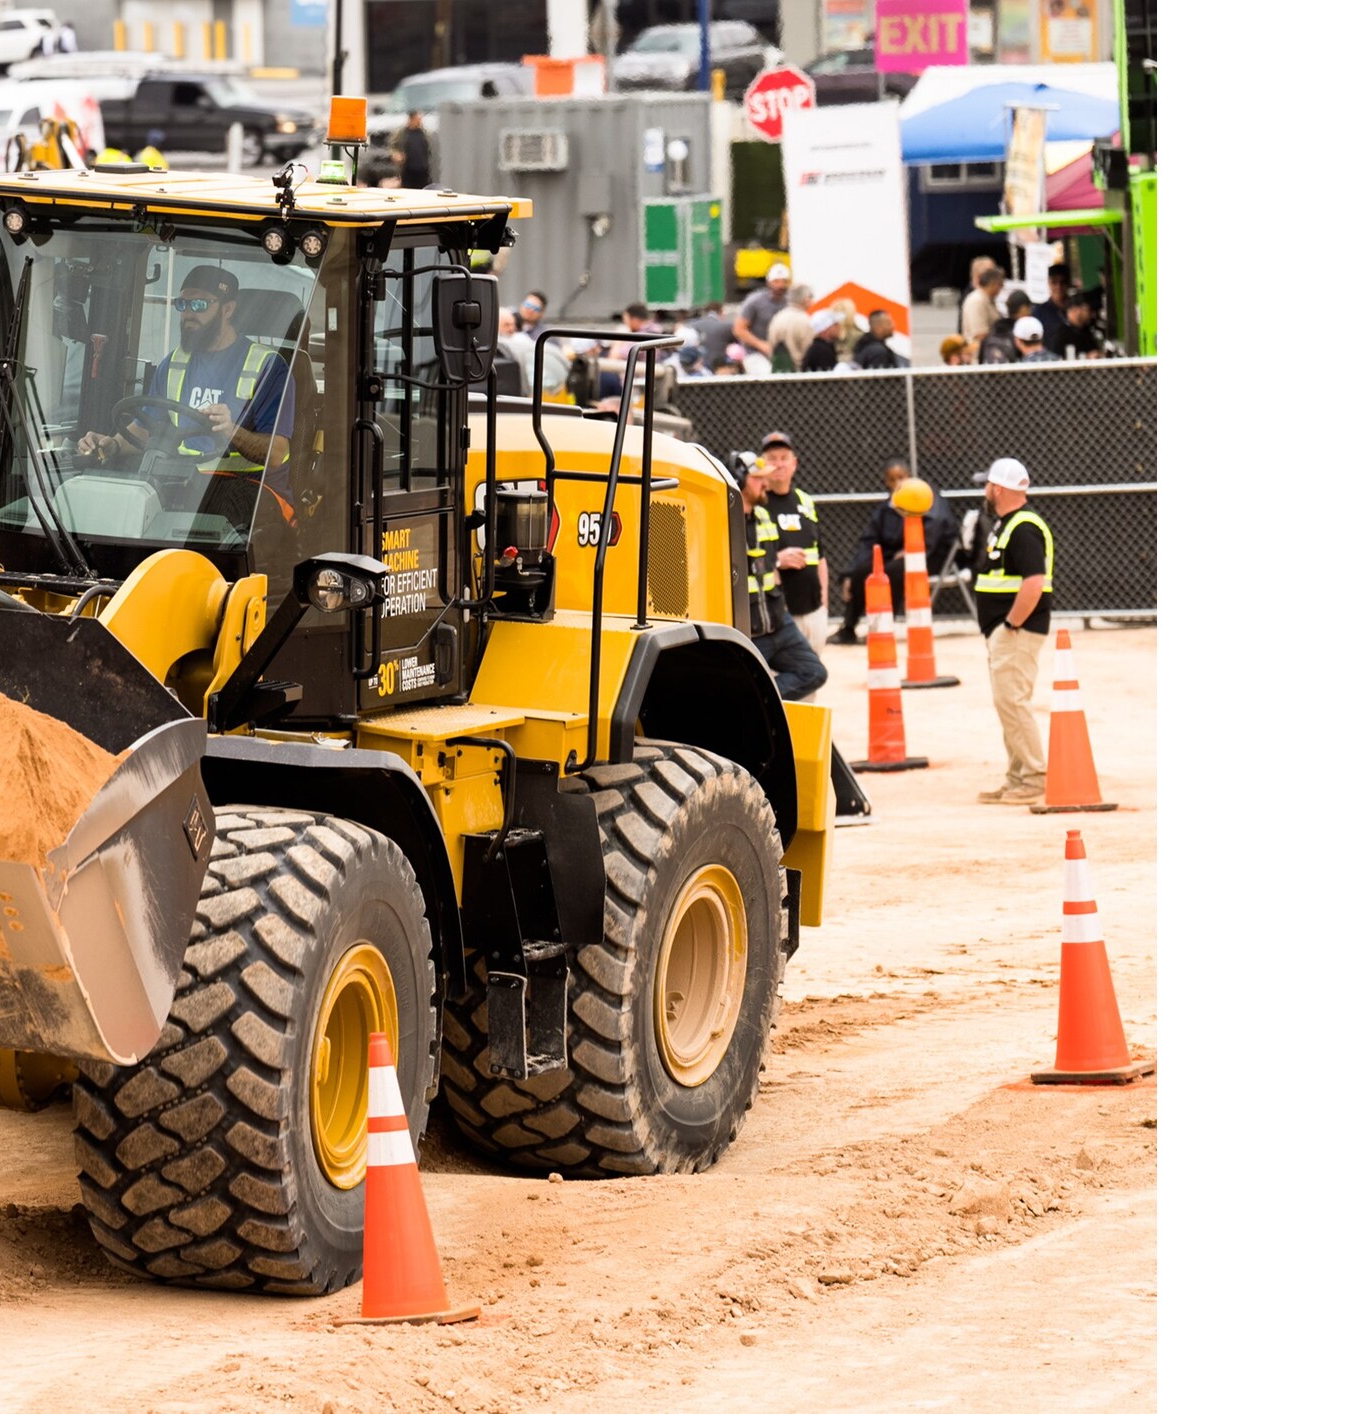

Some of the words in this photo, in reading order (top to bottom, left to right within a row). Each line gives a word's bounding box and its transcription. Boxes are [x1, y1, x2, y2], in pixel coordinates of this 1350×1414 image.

[879, 13, 963, 54] EXIT
[750, 83, 810, 123] STOP
[189, 387, 222, 409] CAT
[578, 512, 612, 546] 95
[397, 568, 438, 593] EFFICIENT
[402, 656, 418, 670] LOWER
[402, 663, 435, 681] MAINTENANCE
[402, 678, 417, 692] COSTS
